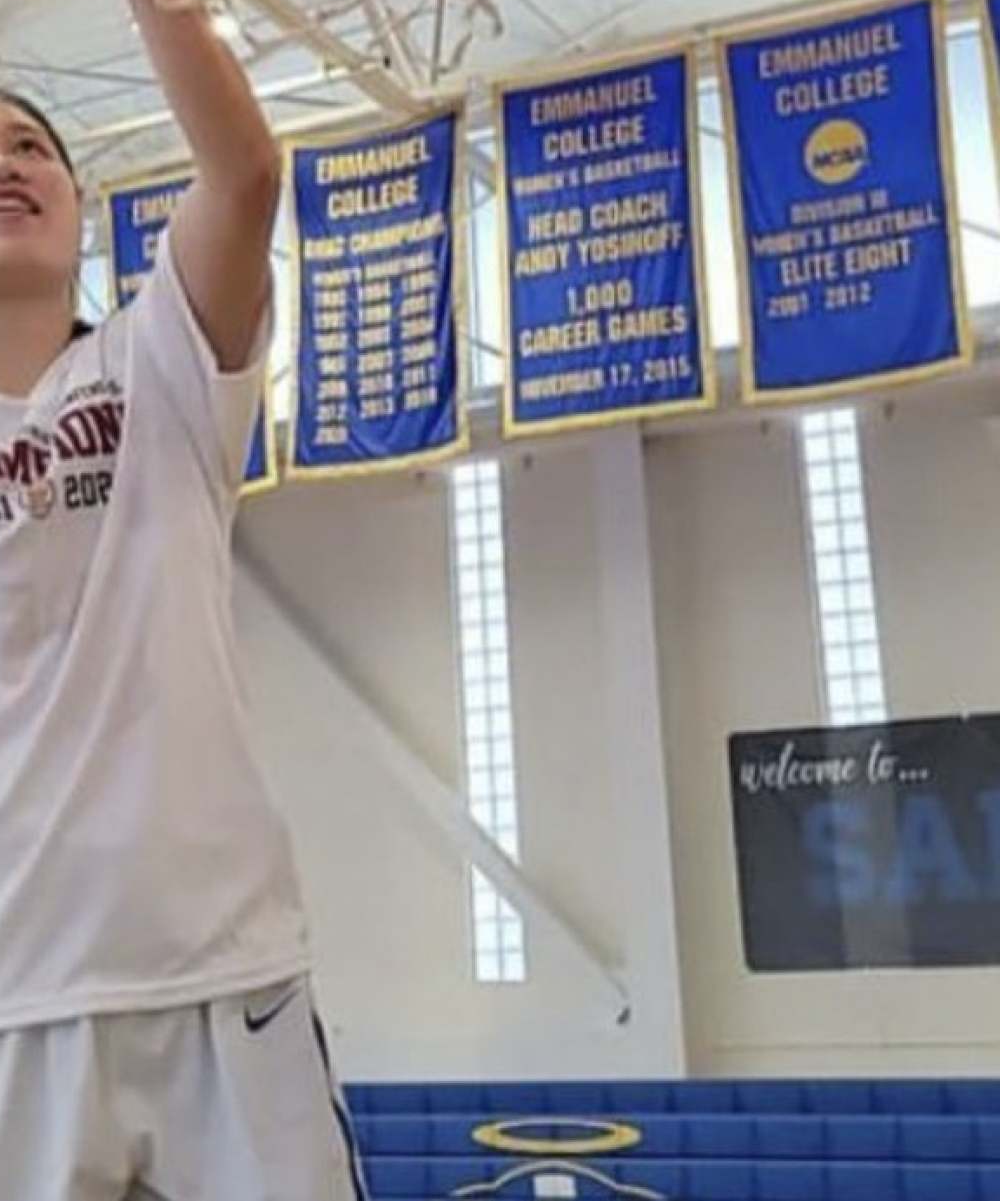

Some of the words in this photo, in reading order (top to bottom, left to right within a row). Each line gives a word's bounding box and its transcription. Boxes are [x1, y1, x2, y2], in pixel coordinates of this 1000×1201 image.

[759, 24, 900, 78] EMMANUEL
[532, 76, 655, 126] EMMANUEL
[776, 65, 890, 116] COLLEGE
[316, 136, 431, 184] EMMANUEL
[544, 115, 644, 162] COLLEGE
[328, 177, 418, 219] COLLEGE
[530, 209, 582, 242] HEAD
[590, 192, 667, 229] COACH
[830, 205, 939, 245] BASKETBALL
[516, 243, 569, 278] ANDY
[577, 223, 682, 265] YOSINOFF
[782, 252, 838, 285] ELITE
[846, 239, 911, 275] EIGHT
[519, 320, 599, 357] CAREER
[608, 307, 687, 341] GAMES
[740, 742, 855, 792] welcome
